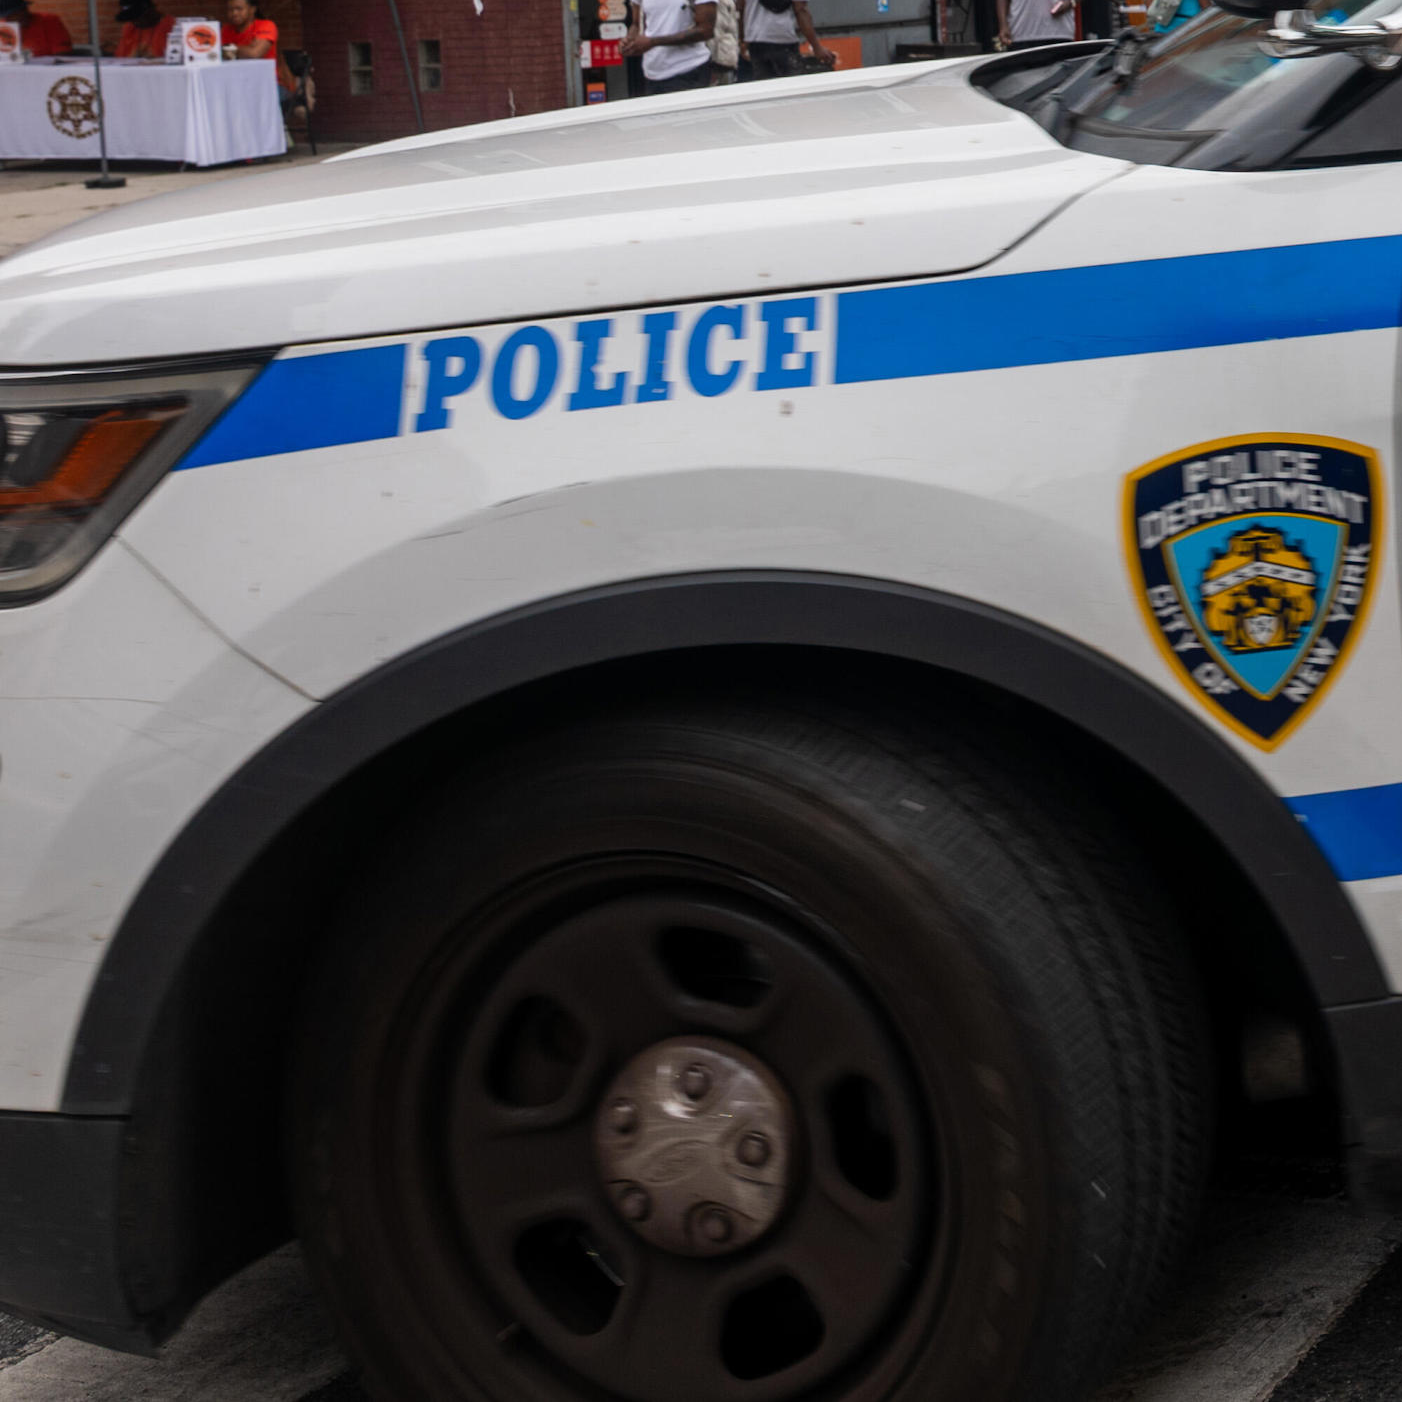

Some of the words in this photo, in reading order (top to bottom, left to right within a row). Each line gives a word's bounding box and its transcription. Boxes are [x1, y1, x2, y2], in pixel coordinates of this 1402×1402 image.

[412, 296, 822, 434] POLICE
[1138, 480, 1370, 549] DEPARTMENT
[1182, 449, 1322, 493] POLICE
[1147, 584, 1205, 653] CITY
[1192, 661, 1241, 695] OF
[1282, 636, 1340, 703] NEW
[1326, 542, 1373, 623] YORK
